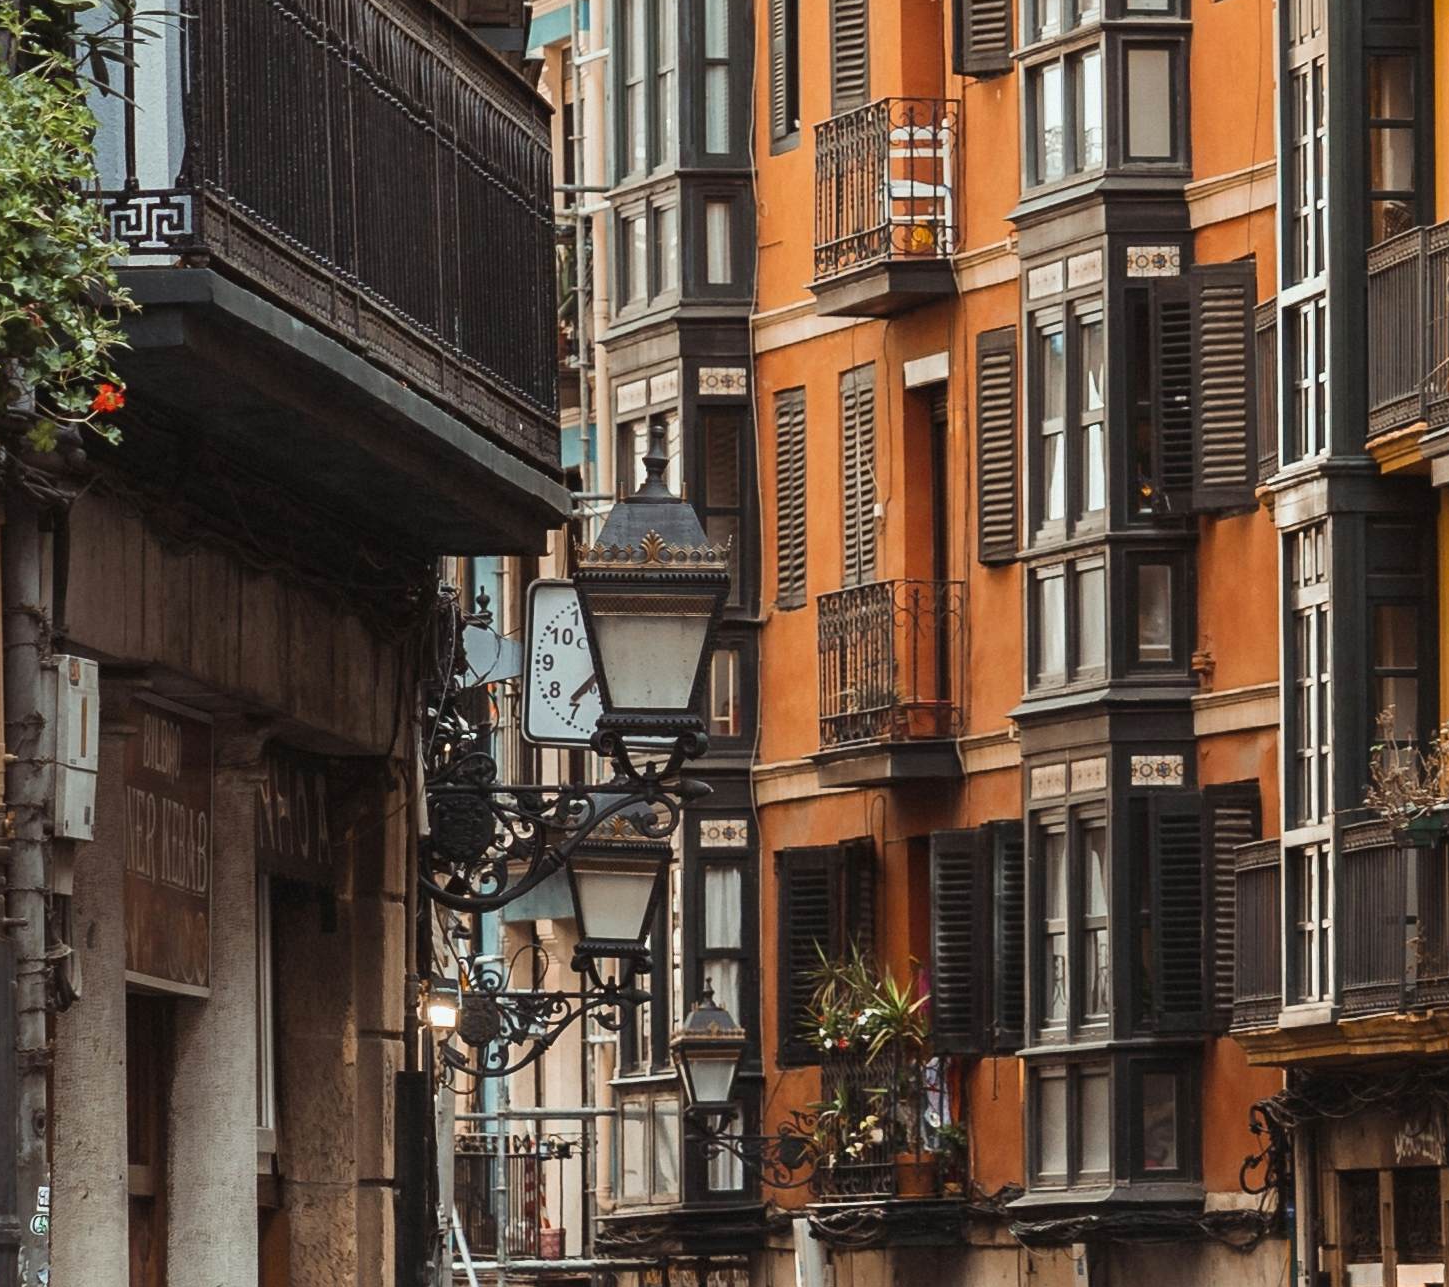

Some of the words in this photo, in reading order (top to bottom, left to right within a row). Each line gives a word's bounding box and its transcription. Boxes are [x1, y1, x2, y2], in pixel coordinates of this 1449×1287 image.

[550, 628, 573, 645] 10
[543, 654, 554, 671] 9
[549, 681, 561, 698] 8
[569, 703, 580, 719] 7
[161, 798, 207, 893] KEBAB
